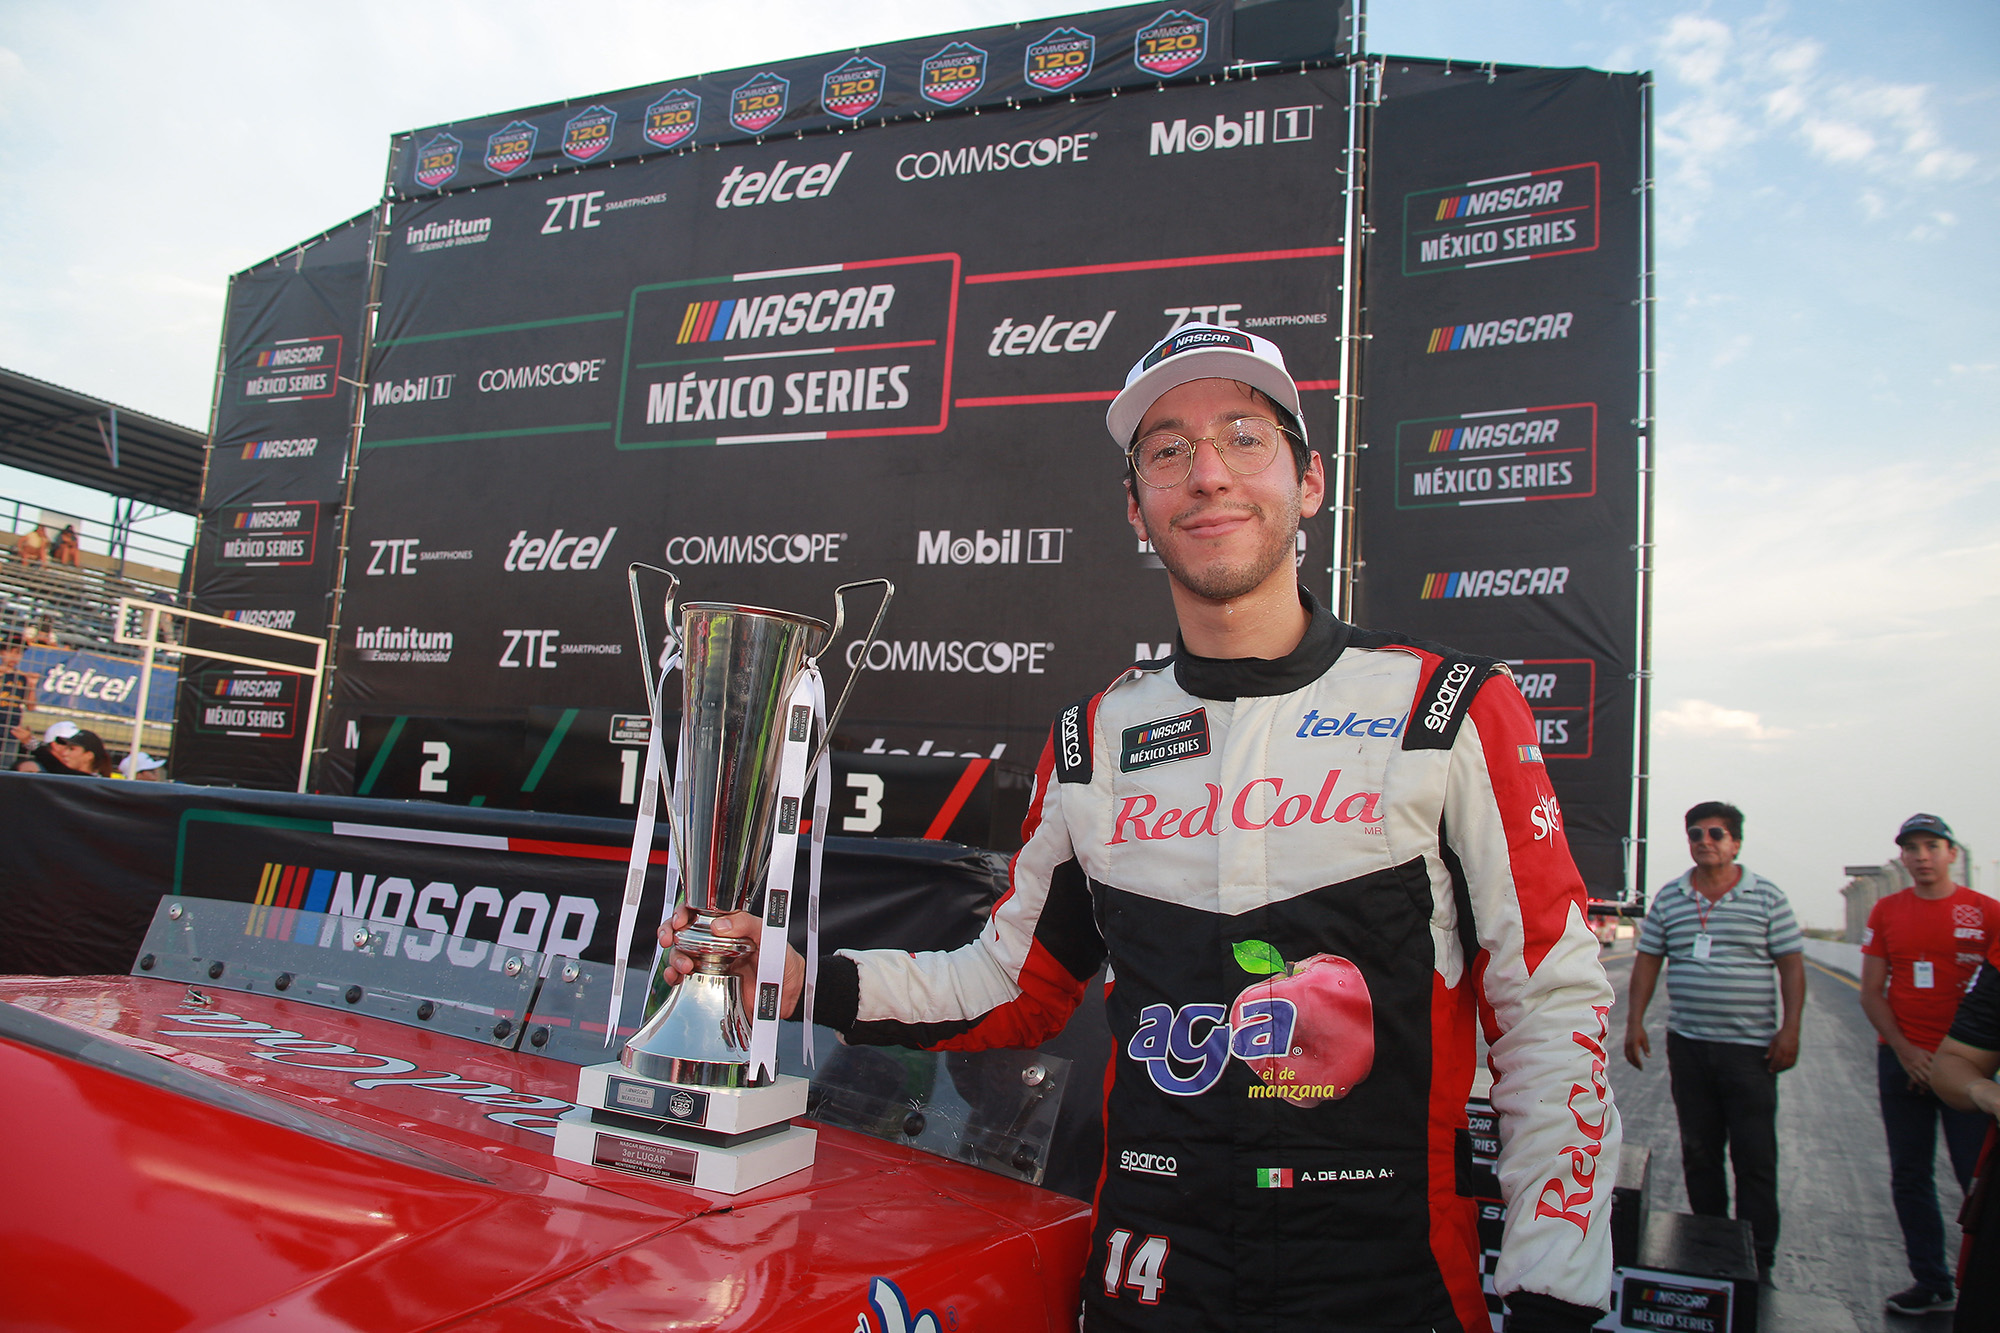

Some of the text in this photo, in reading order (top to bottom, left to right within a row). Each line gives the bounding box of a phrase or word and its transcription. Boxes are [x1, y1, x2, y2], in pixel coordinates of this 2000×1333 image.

[1146, 34, 1197, 53] 120
[1034, 51, 1085, 69] 120
[830, 79, 875, 96] 120
[930, 65, 977, 83] 120
[739, 94, 779, 111] 120
[653, 110, 691, 126] 120
[570, 125, 607, 141] 120
[1150, 110, 1264, 156] Mobil
[423, 154, 454, 168] 120
[493, 140, 529, 155] 120
[715, 151, 853, 209] telcel
[1465, 180, 1563, 217] NASCAR
[540, 190, 667, 235] ZTE SMARTPHONES
[406, 217, 492, 245] infinitum
[1421, 218, 1576, 263] MÉXICO SERIES
[725, 284, 895, 341] NASCAR
[1245, 313, 1327, 328] SMARTPHONES
[987, 310, 1117, 357] telcel
[1176, 333, 1231, 349] NASCAR
[1460, 312, 1574, 350] NASCAR
[272, 346, 324, 366] NASCAR
[246, 374, 327, 396] MÉXICO SERIES
[373, 376, 428, 407] Mobil
[646, 366, 910, 425] MÉXICO SERIES
[258, 438, 319, 459] NASCAR
[1459, 419, 1560, 451] NASCAR
[1414, 461, 1573, 496] MÉXICO SERIES
[249, 510, 301, 529] NASCAR
[366, 539, 473, 576] ZTE SMARTPHONES
[503, 526, 618, 572] telcel
[916, 529, 1020, 565] Mobil
[1455, 566, 1570, 598] NASCAR
[355, 626, 454, 649] infinitum
[499, 629, 621, 668] ZTE SMARTPHONES
[43, 664, 137, 703] telcel
[230, 680, 282, 698] NASCAR
[1422, 662, 1476, 734] sparco
[1150, 719, 1192, 741] NASCAR
[1296, 710, 1409, 739] telcel
[1061, 706, 1082, 771] sparco
[1130, 739, 1200, 764] MÉXICO SERIES
[419, 741, 451, 792] 2
[619, 749, 639, 804] 1
[843, 773, 884, 832] 3
[1105, 769, 1384, 846] Red Cola
[1364, 826, 1382, 835] MR
[319, 872, 600, 979] NASCAR
[1127, 997, 1298, 1096] aga
[1262, 1066, 1295, 1080] el de
[673, 1101, 690, 1109] 120
[1248, 1083, 1335, 1101] manzana
[1468, 1118, 1492, 1131] CAR
[622, 1148, 666, 1164] 3er LUGAR
[1120, 1150, 1178, 1177] sparco
[1318, 1170, 1337, 1181] DE
[1339, 1169, 1375, 1180] ALBA
[1103, 1228, 1170, 1305] 14
[1657, 1291, 1709, 1309] NASCAR
[1632, 1307, 1715, 1332] MÉXICO SERIES
